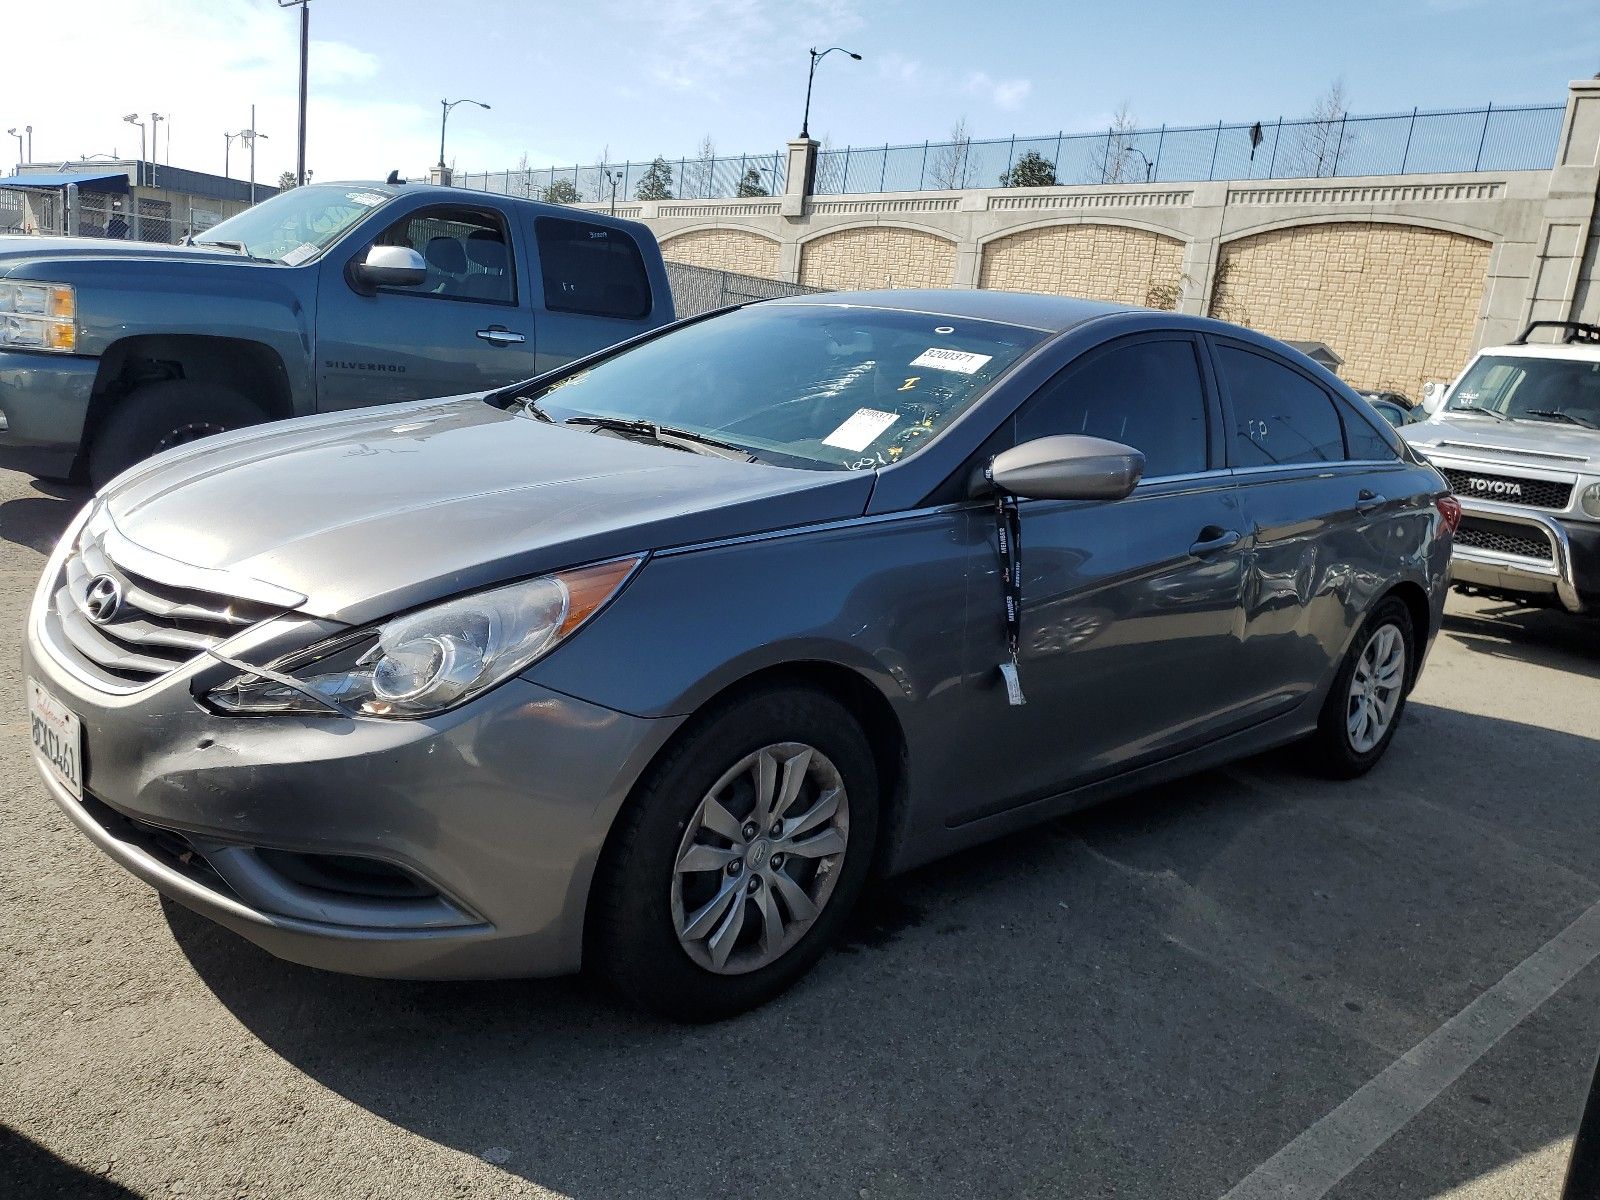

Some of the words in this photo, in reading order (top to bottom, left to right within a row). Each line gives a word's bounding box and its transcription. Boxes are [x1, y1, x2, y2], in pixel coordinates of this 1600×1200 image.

[924, 349, 976, 363] 3200371
[325, 360, 406, 373] SILVERADO
[1469, 477, 1522, 496] TOYOTA
[999, 527, 1008, 554] MEMBER
[1006, 595, 1015, 622] MEMBER
